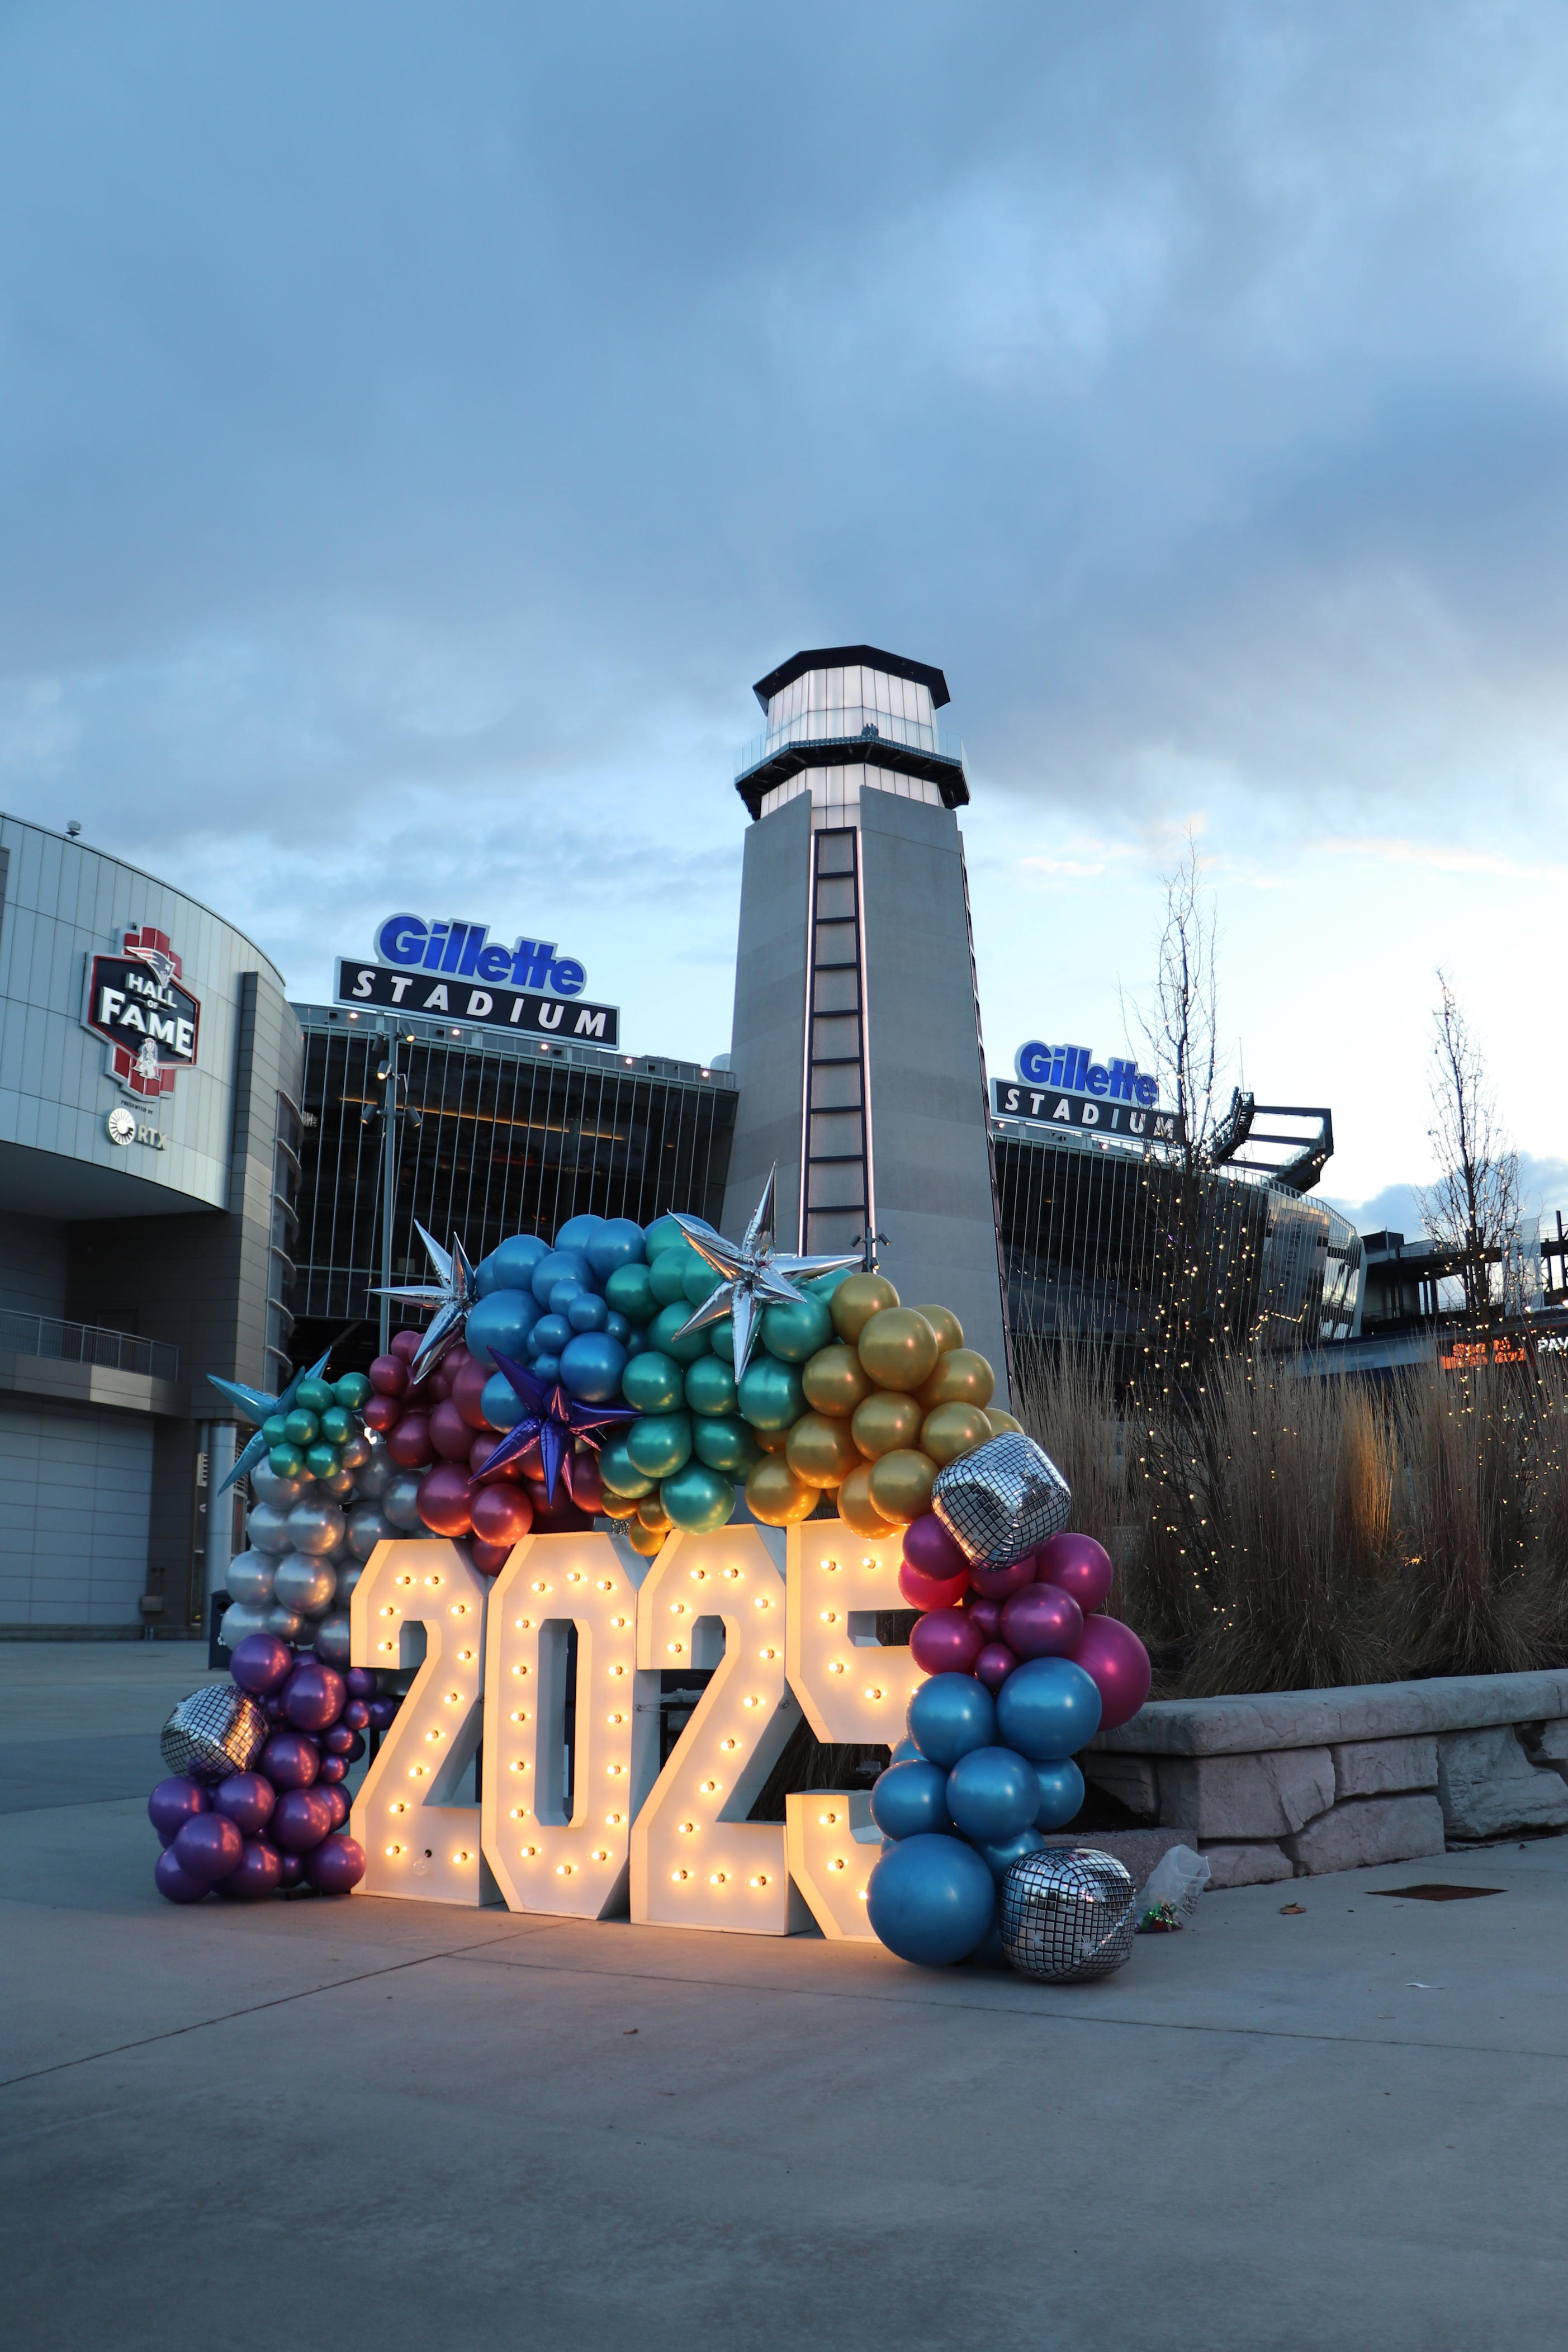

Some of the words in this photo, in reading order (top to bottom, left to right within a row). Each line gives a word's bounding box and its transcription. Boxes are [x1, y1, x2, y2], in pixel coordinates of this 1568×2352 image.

[378, 915, 584, 996] Gillette
[128, 972, 178, 1009] HALL
[147, 999, 159, 1010] OF
[352, 970, 607, 1038] STADIUM
[100, 986, 195, 1058] FAME
[1020, 1042, 1158, 1105] Gillette
[121, 1100, 146, 1113] PRESENTED
[1005, 1088, 1174, 1140] STADIUM
[138, 1124, 167, 1151] RTX
[350, 1518, 928, 1944] 2025
